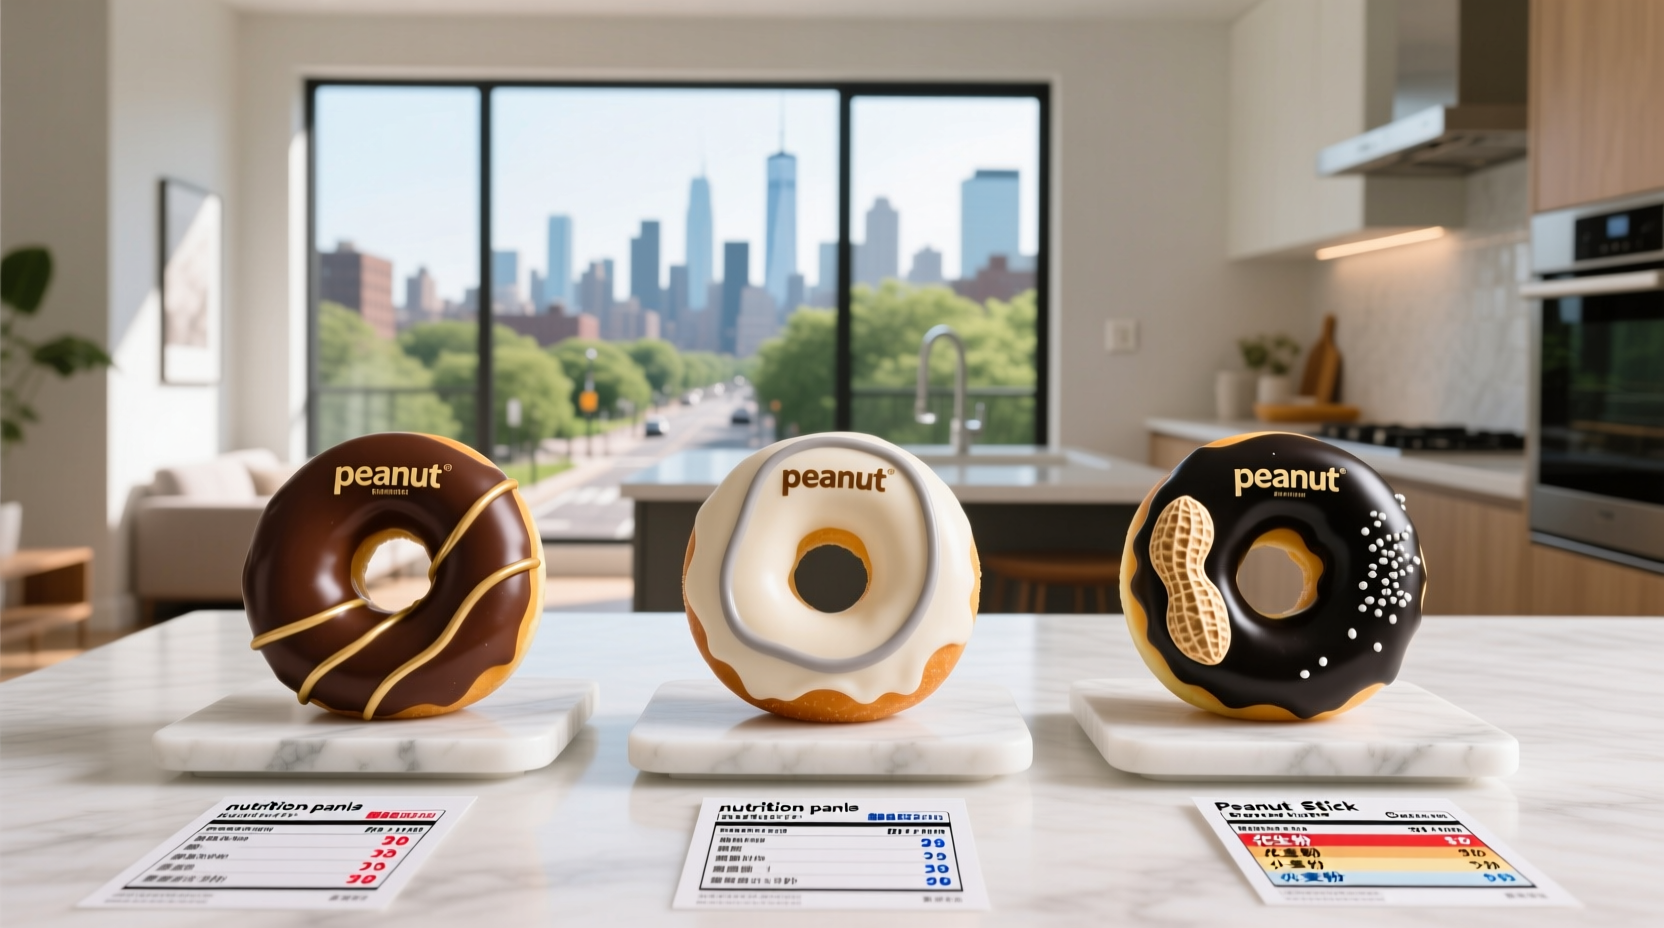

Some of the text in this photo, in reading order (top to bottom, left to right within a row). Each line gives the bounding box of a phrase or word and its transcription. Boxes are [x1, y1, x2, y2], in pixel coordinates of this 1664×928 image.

[719, 801, 805, 813] nutrition
[1214, 800, 1360, 812] Peanut Stick
